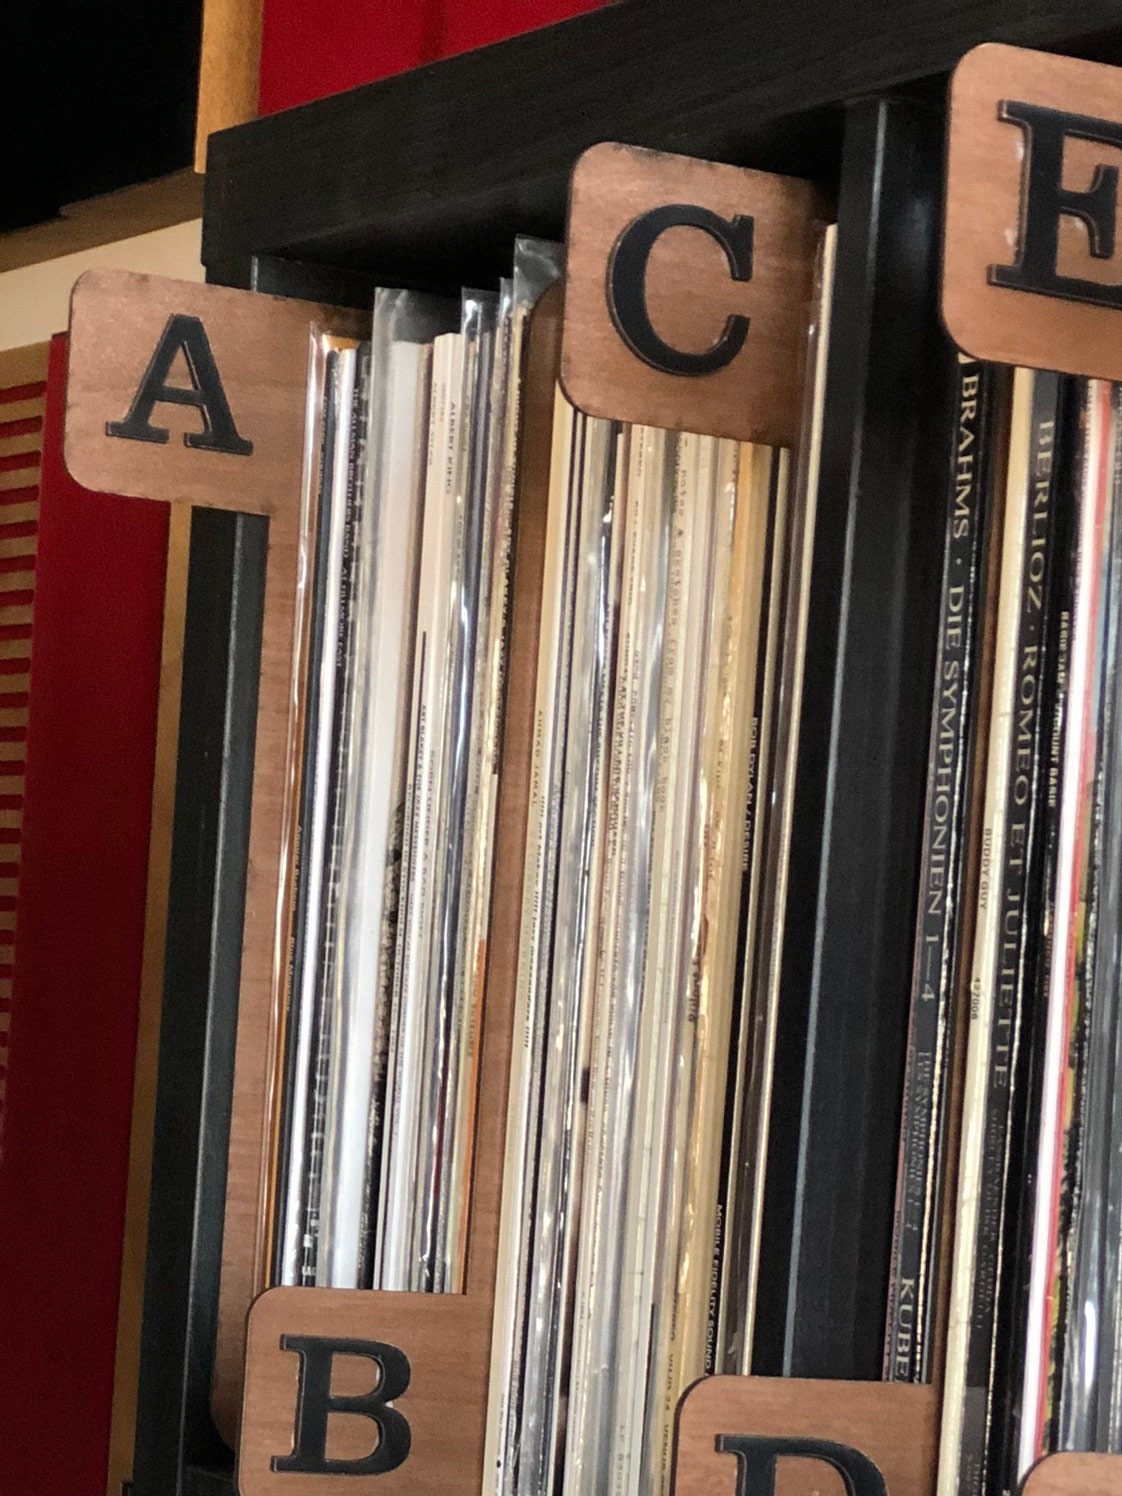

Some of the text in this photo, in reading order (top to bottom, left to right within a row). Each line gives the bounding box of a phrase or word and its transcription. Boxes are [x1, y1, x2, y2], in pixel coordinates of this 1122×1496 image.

[606, 205, 754, 379] C
[106, 315, 253, 456] A
[927, 374, 979, 914] BRAHMS DIE SYMPHONIEN
[992, 420, 1055, 1089] BERLIOZ ROMEO ET JULIETTE
[1047, 767, 1058, 808] BASIE
[979, 828, 992, 910] BUDDY GUY
[704, 1204, 723, 1368] MOBILE FIDELITY SOUND
[276, 1335, 411, 1476] B
